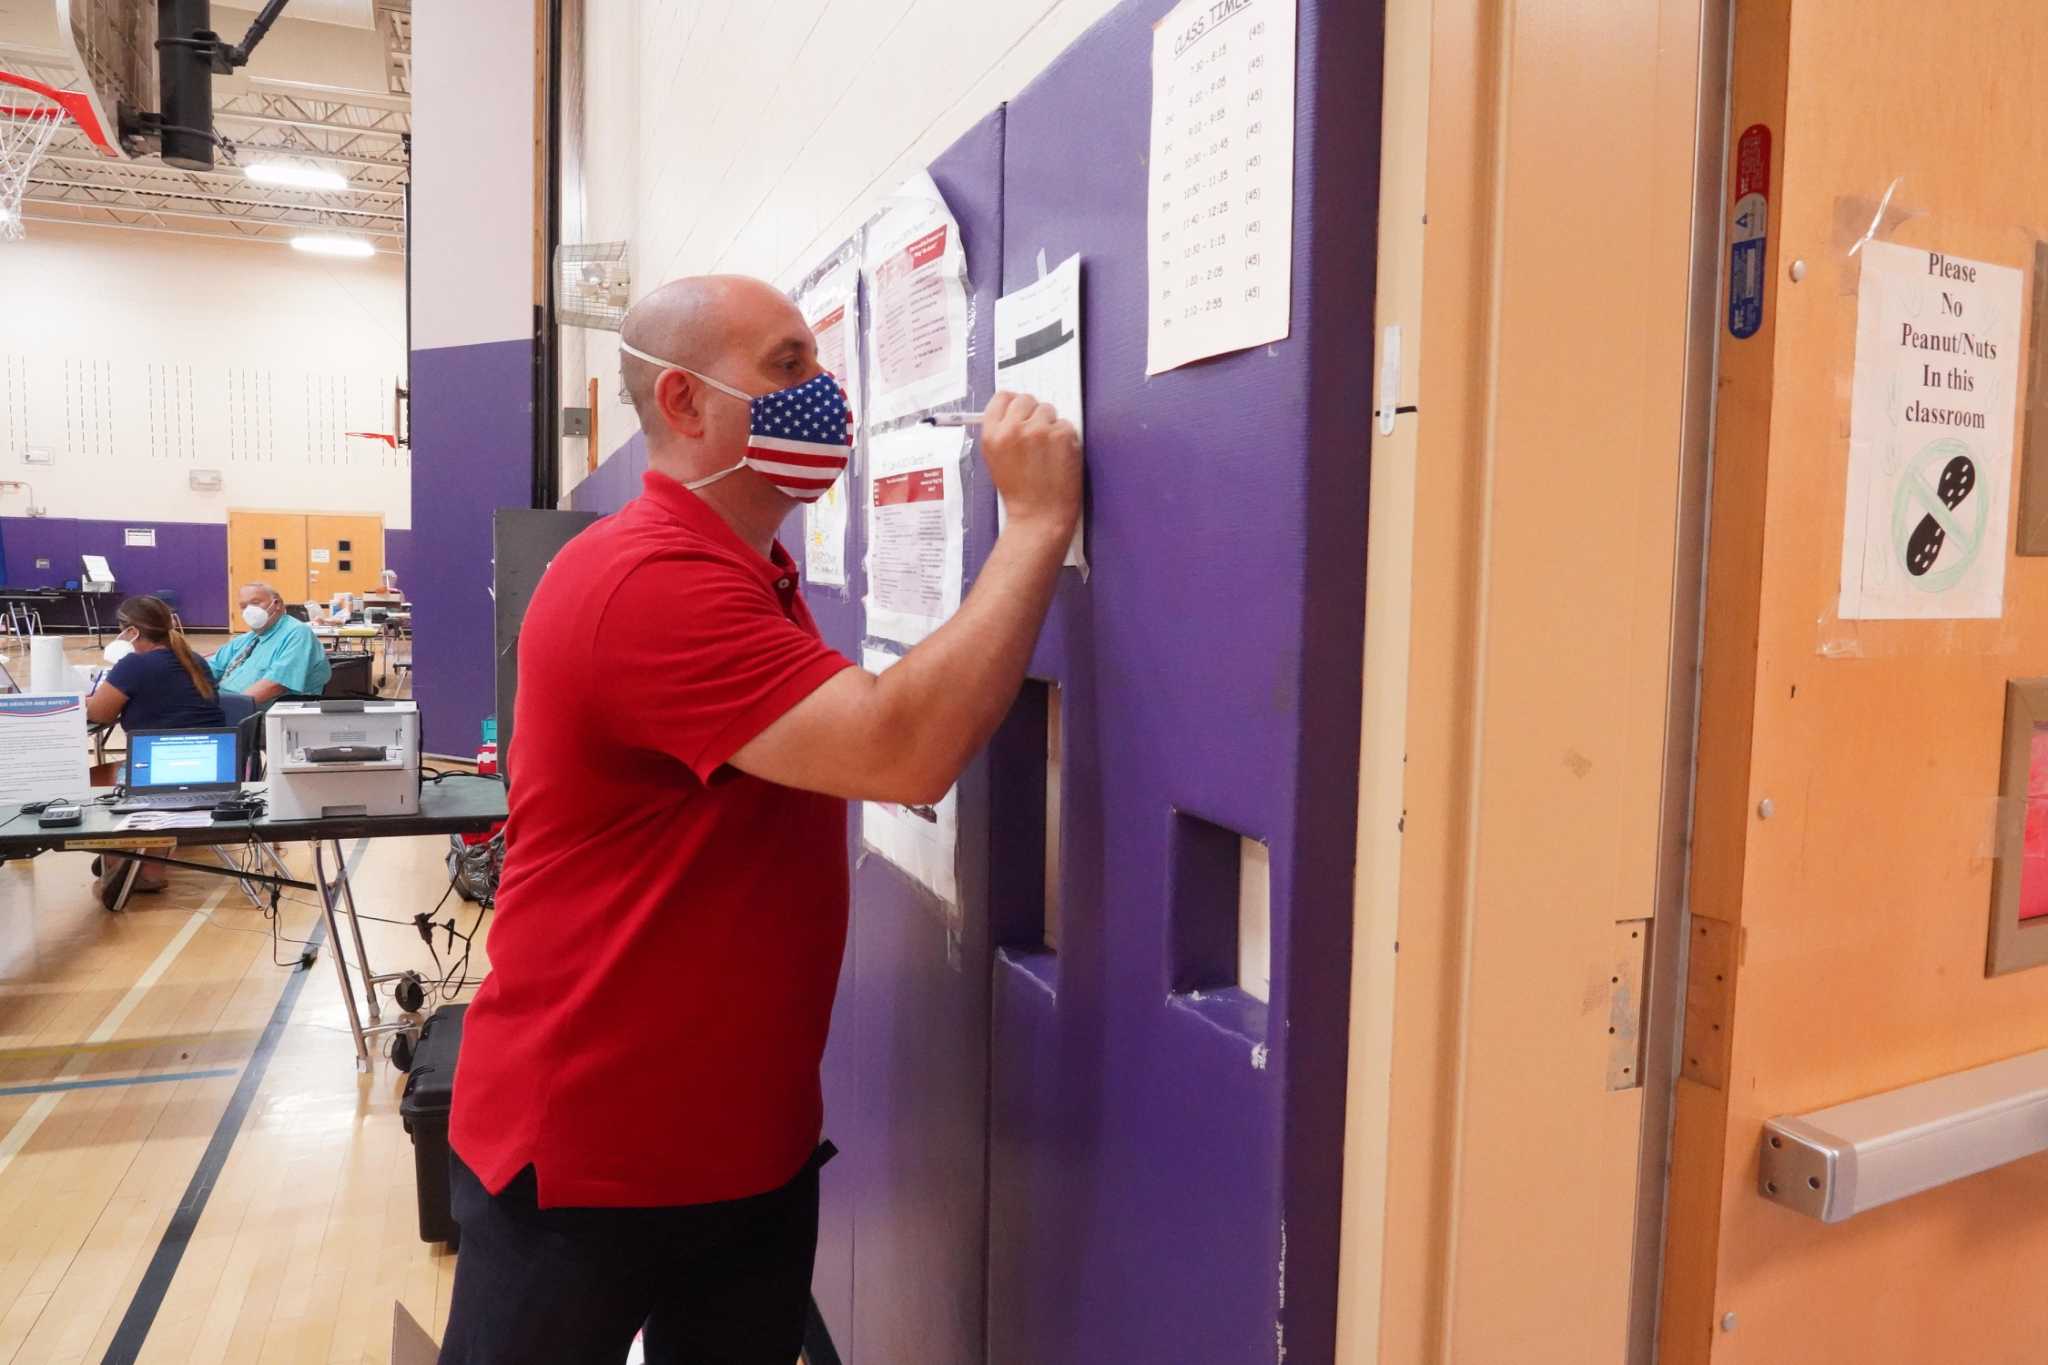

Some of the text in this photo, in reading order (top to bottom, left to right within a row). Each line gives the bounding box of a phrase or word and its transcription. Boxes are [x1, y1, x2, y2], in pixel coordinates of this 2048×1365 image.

[1174, 0, 1250, 55] CLASS TIME
[1246, 121, 1262, 140] (45)
[1245, 154, 1261, 172] (45)
[1245, 187, 1261, 205] (45)
[1245, 220, 1261, 239] (45)
[1244, 253, 1261, 271] (45)
[1928, 252, 1976, 283] Please
[1244, 286, 1260, 303] (45)
[1941, 291, 1963, 318] No
[1901, 322, 1997, 360] Peanut/Nuts
[1923, 364, 1974, 392] In this
[1905, 400, 1985, 429] classroom
